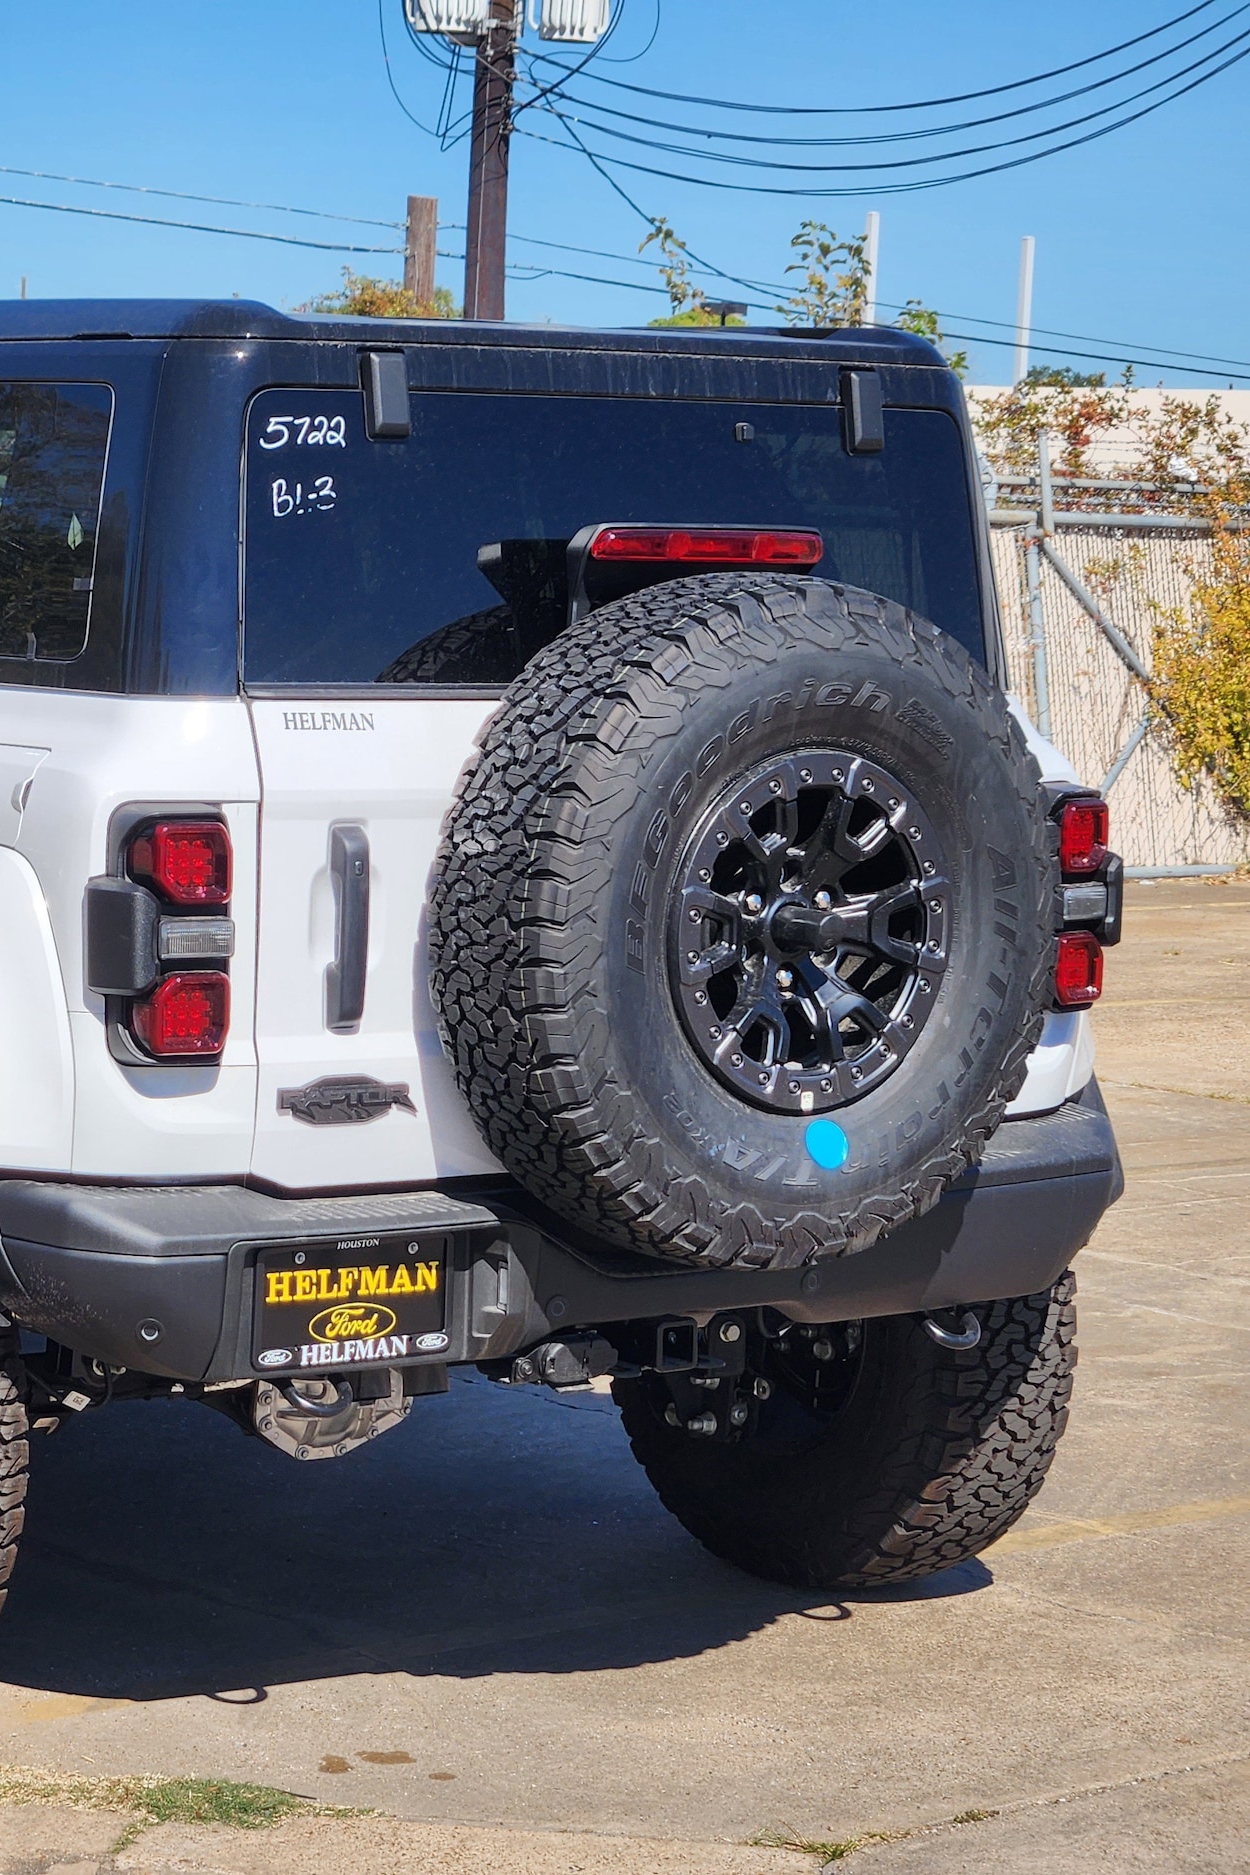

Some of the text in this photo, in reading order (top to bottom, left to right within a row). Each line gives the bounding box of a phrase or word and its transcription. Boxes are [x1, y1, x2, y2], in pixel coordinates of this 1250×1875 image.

[259, 415, 346, 449] 5722
[281, 712, 375, 731] HELFMAN
[625, 679, 893, 976] BFGoodrich
[280, 1083, 418, 1119] RAPTOR
[723, 1135, 819, 1187] T/A
[336, 1238, 380, 1251] HOUSTON
[265, 1260, 440, 1304] HELFMAN
[324, 1308, 379, 1338] Ford
[262, 1335, 445, 1367] Ford HELFMAN Ford
